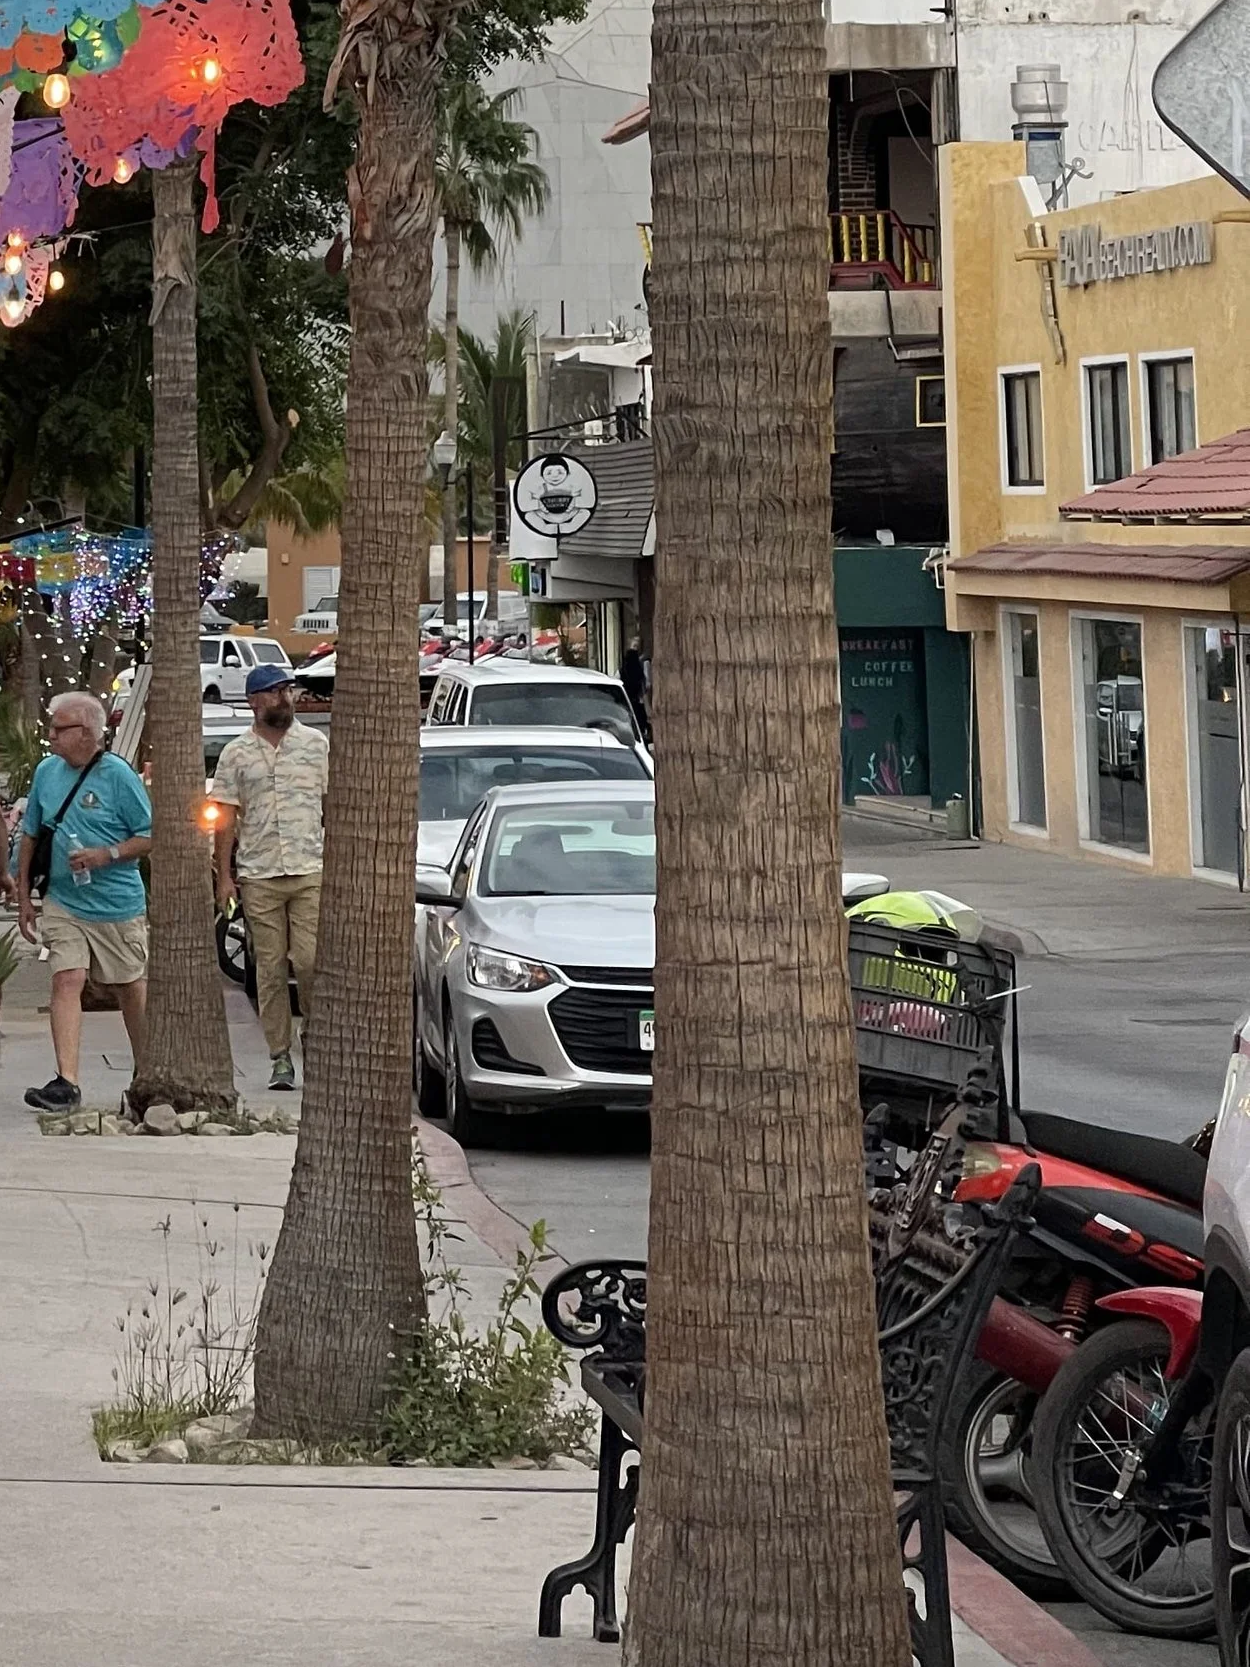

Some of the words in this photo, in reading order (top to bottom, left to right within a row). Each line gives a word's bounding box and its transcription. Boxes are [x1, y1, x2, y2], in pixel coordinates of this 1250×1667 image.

[842, 638, 914, 651] BREAKFAST
[864, 660, 914, 673] COFFEE
[851, 676, 893, 688] LUNCH
